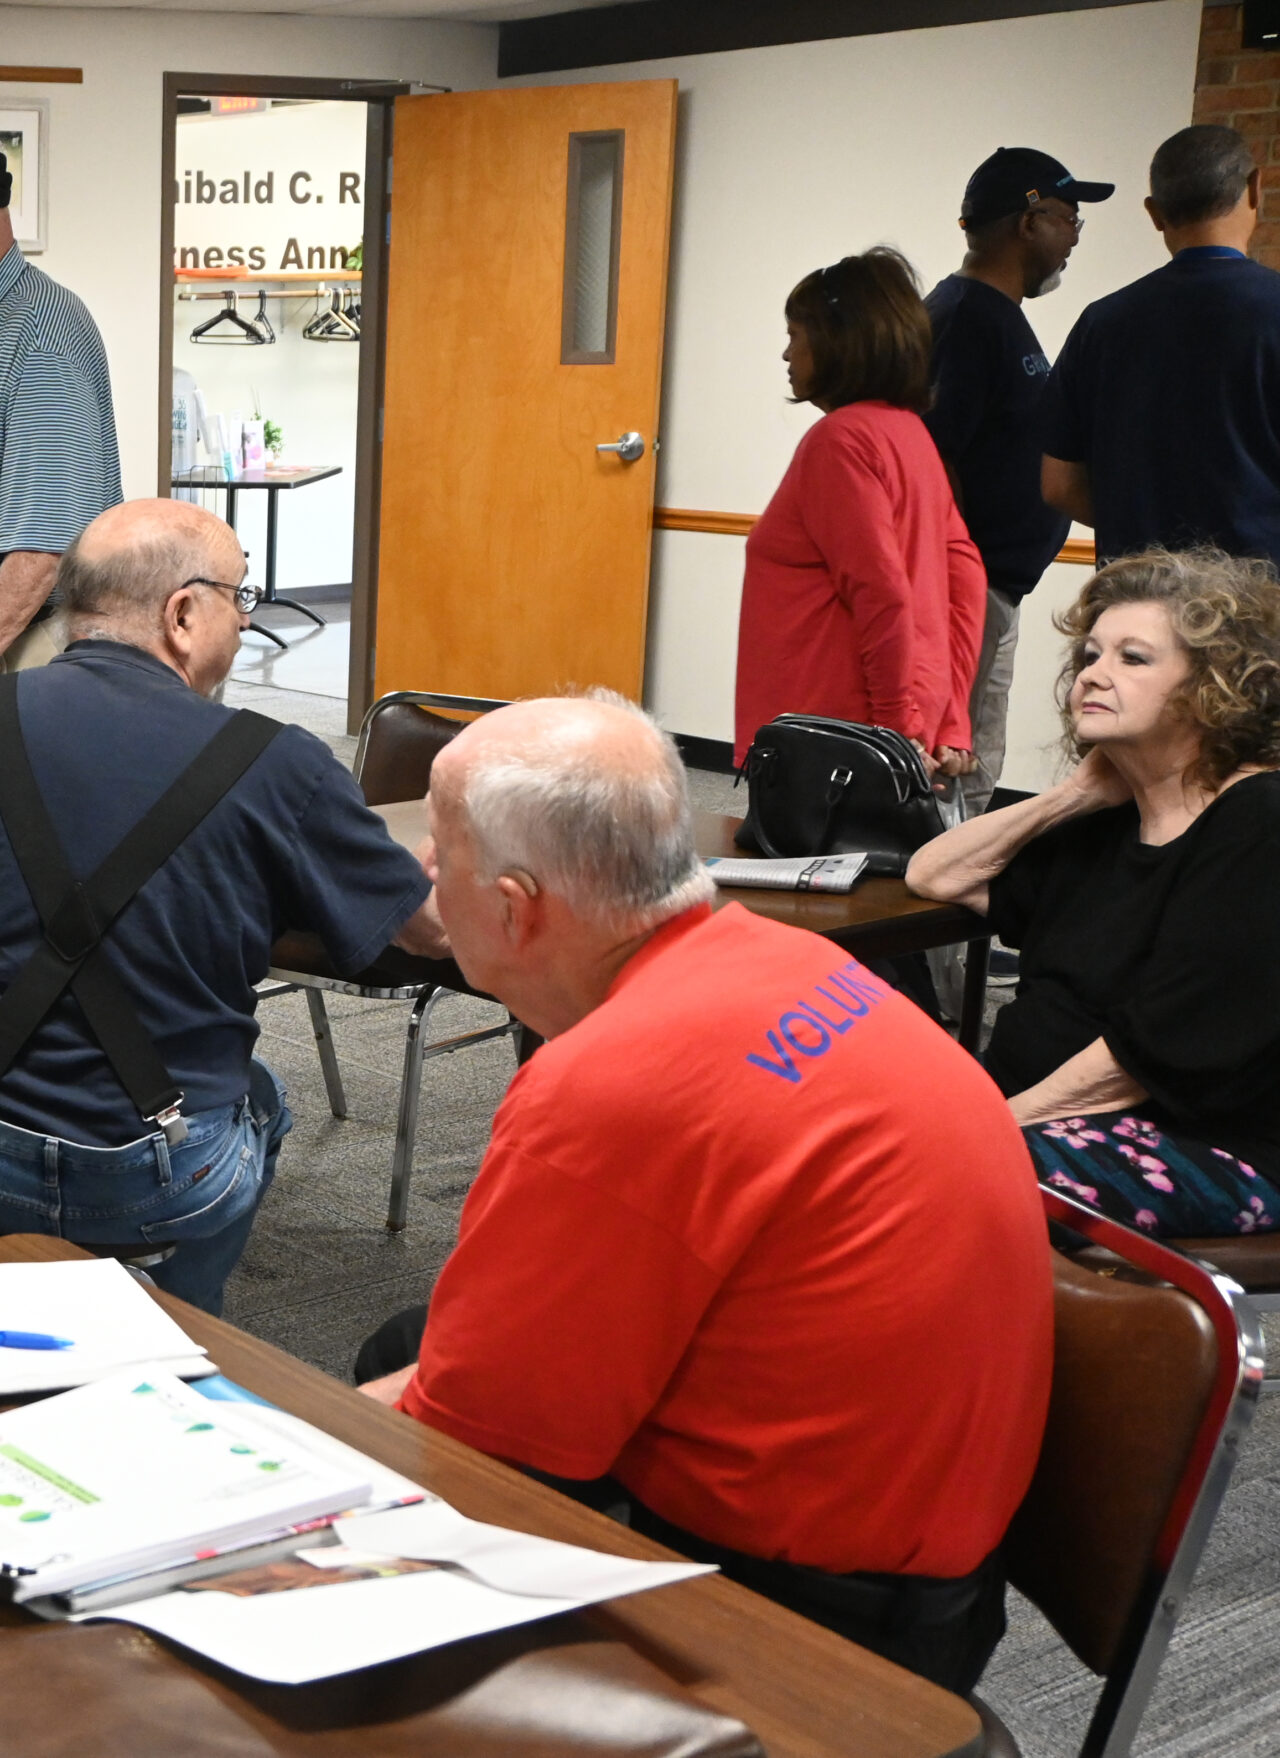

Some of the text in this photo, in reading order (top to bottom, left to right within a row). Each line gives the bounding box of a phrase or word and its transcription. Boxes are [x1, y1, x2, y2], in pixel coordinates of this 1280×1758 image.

[175, 170, 274, 204] ibald
[289, 170, 323, 204] C.
[175, 246, 266, 270] ness
